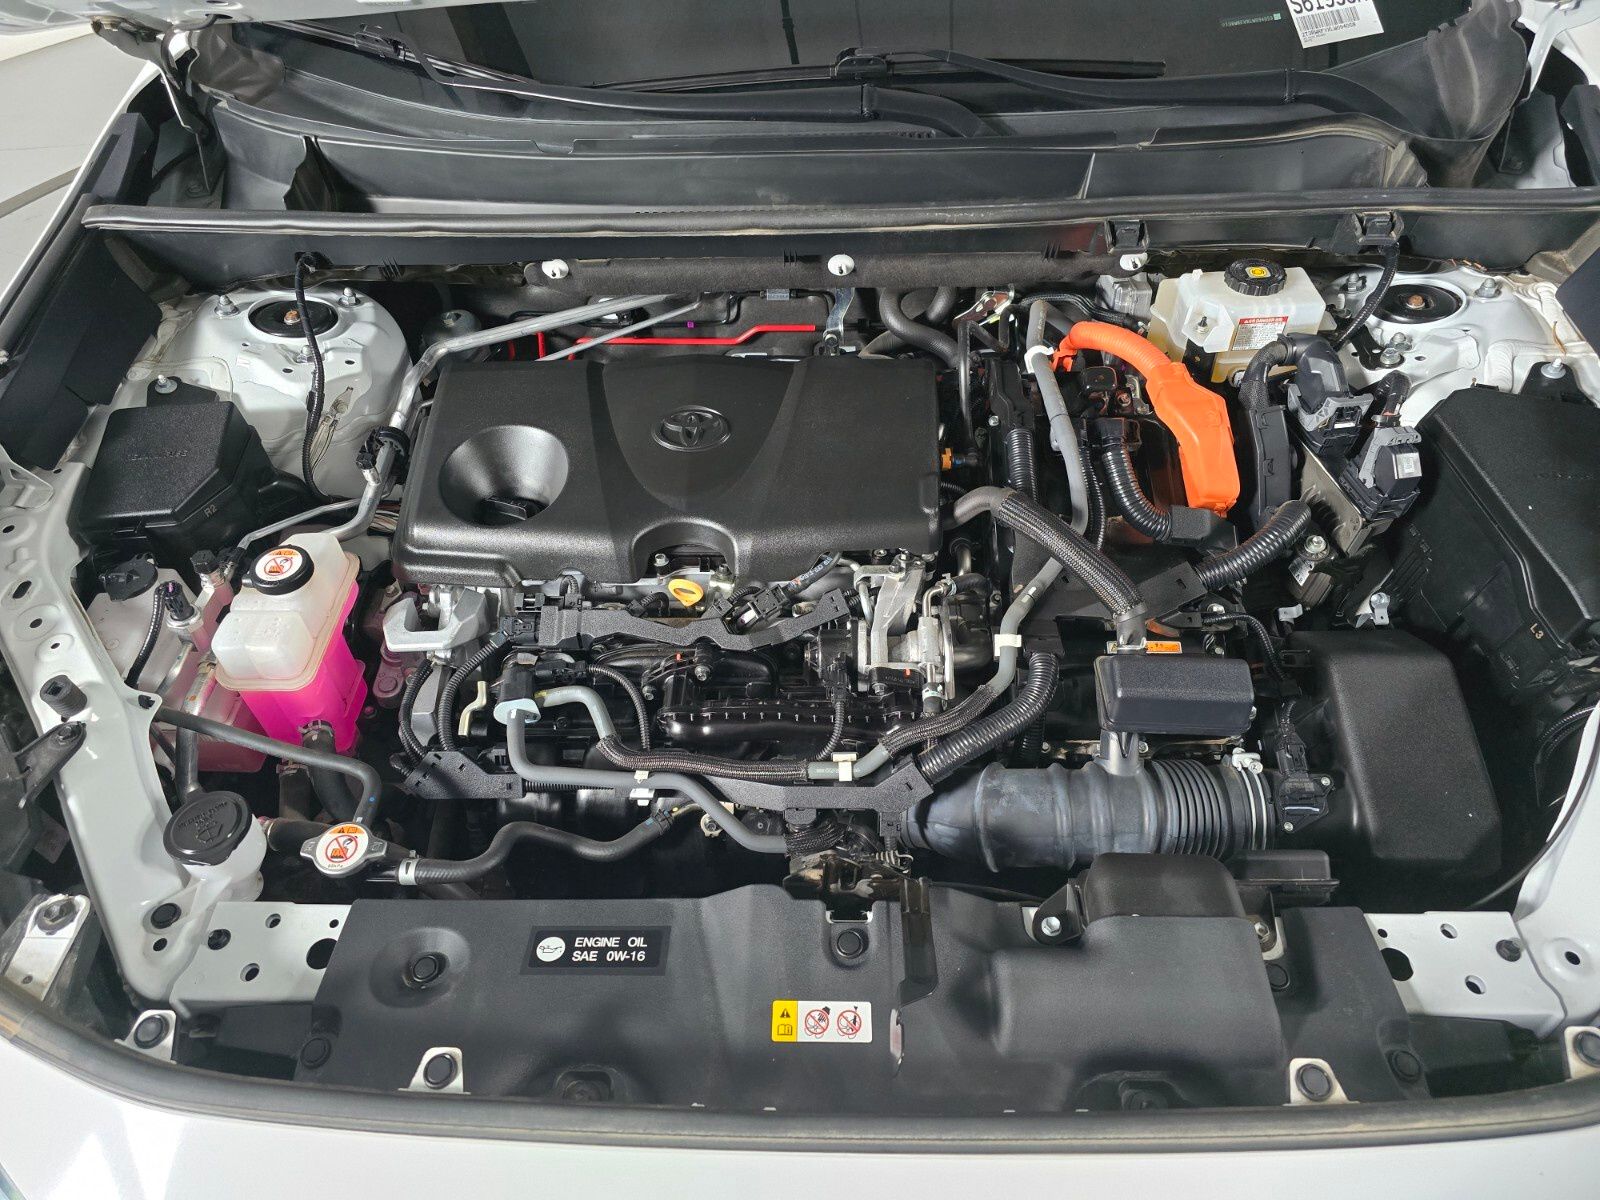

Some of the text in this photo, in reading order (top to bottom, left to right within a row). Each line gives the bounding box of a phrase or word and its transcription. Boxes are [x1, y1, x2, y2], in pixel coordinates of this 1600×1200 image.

[204, 504, 217, 517] R2
[1530, 623, 1544, 639] L3
[574, 937, 648, 948] ENGINE OIL
[571, 950, 646, 962] SAE 0W-16
